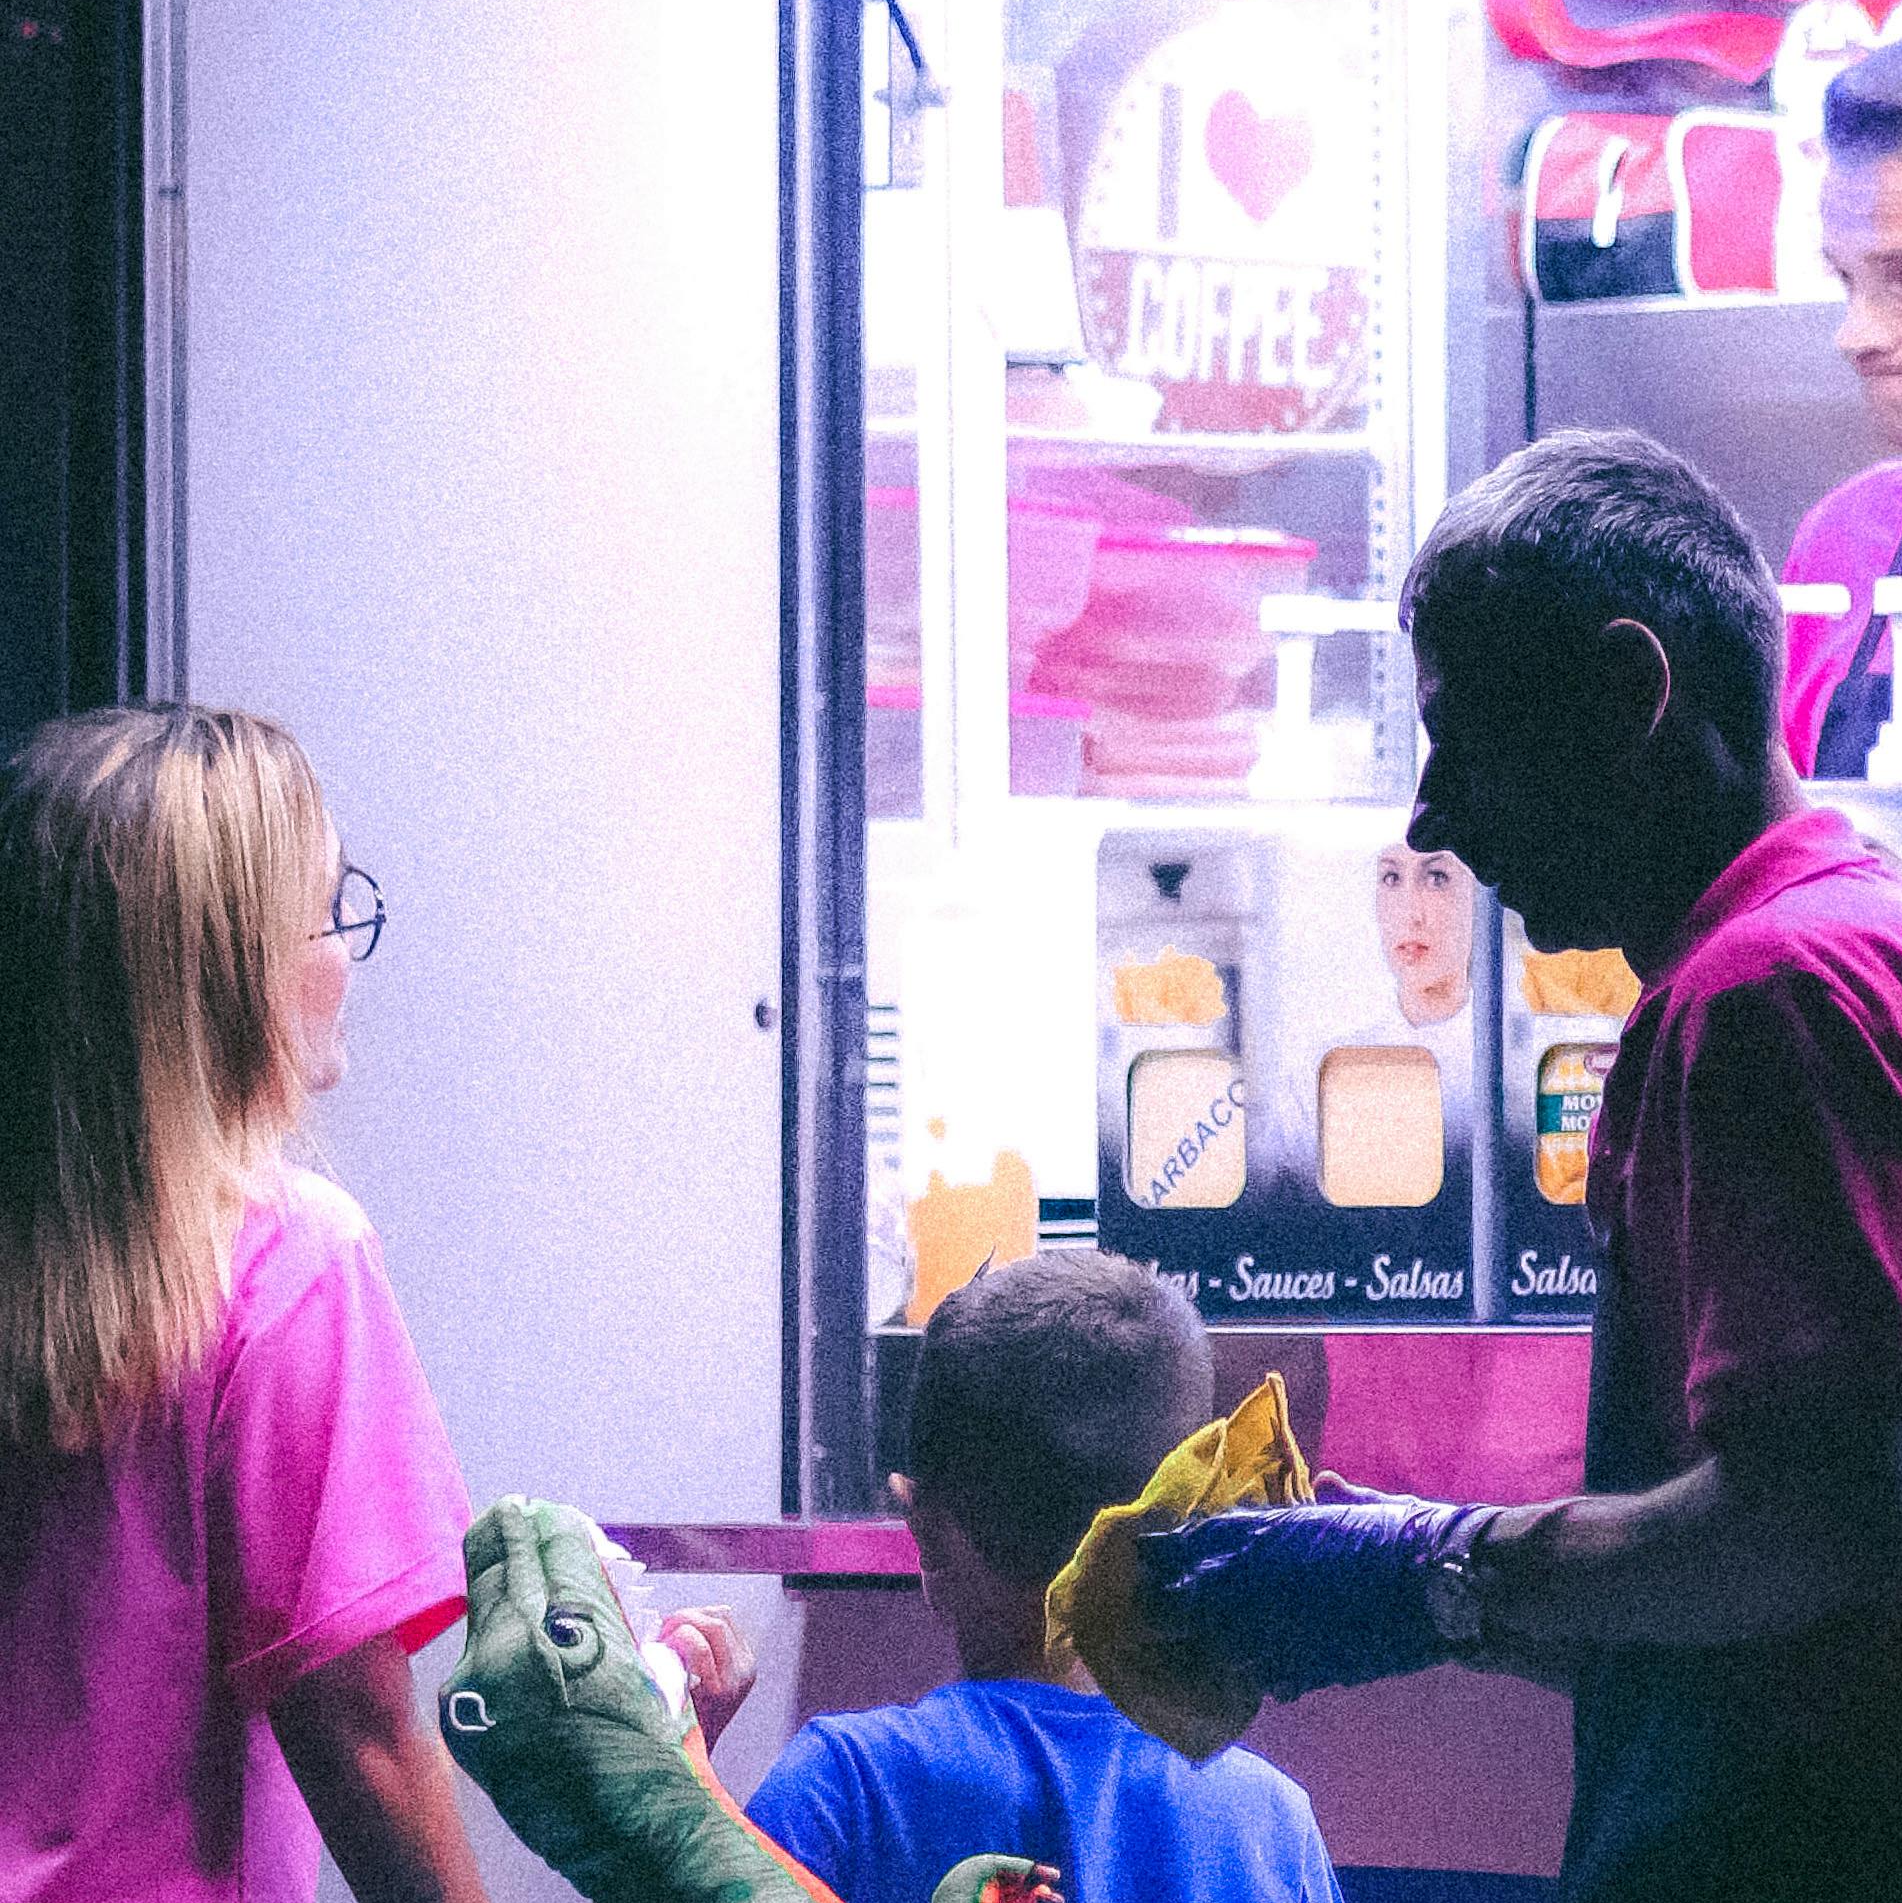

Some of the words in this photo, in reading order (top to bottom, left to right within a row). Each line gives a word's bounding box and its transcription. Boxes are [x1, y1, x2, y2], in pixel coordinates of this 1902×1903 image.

[1228, 1252, 1336, 1301] Sauces
[1365, 1253, 1465, 1302] Salsas
[1510, 1249, 1598, 1298] Salsa
